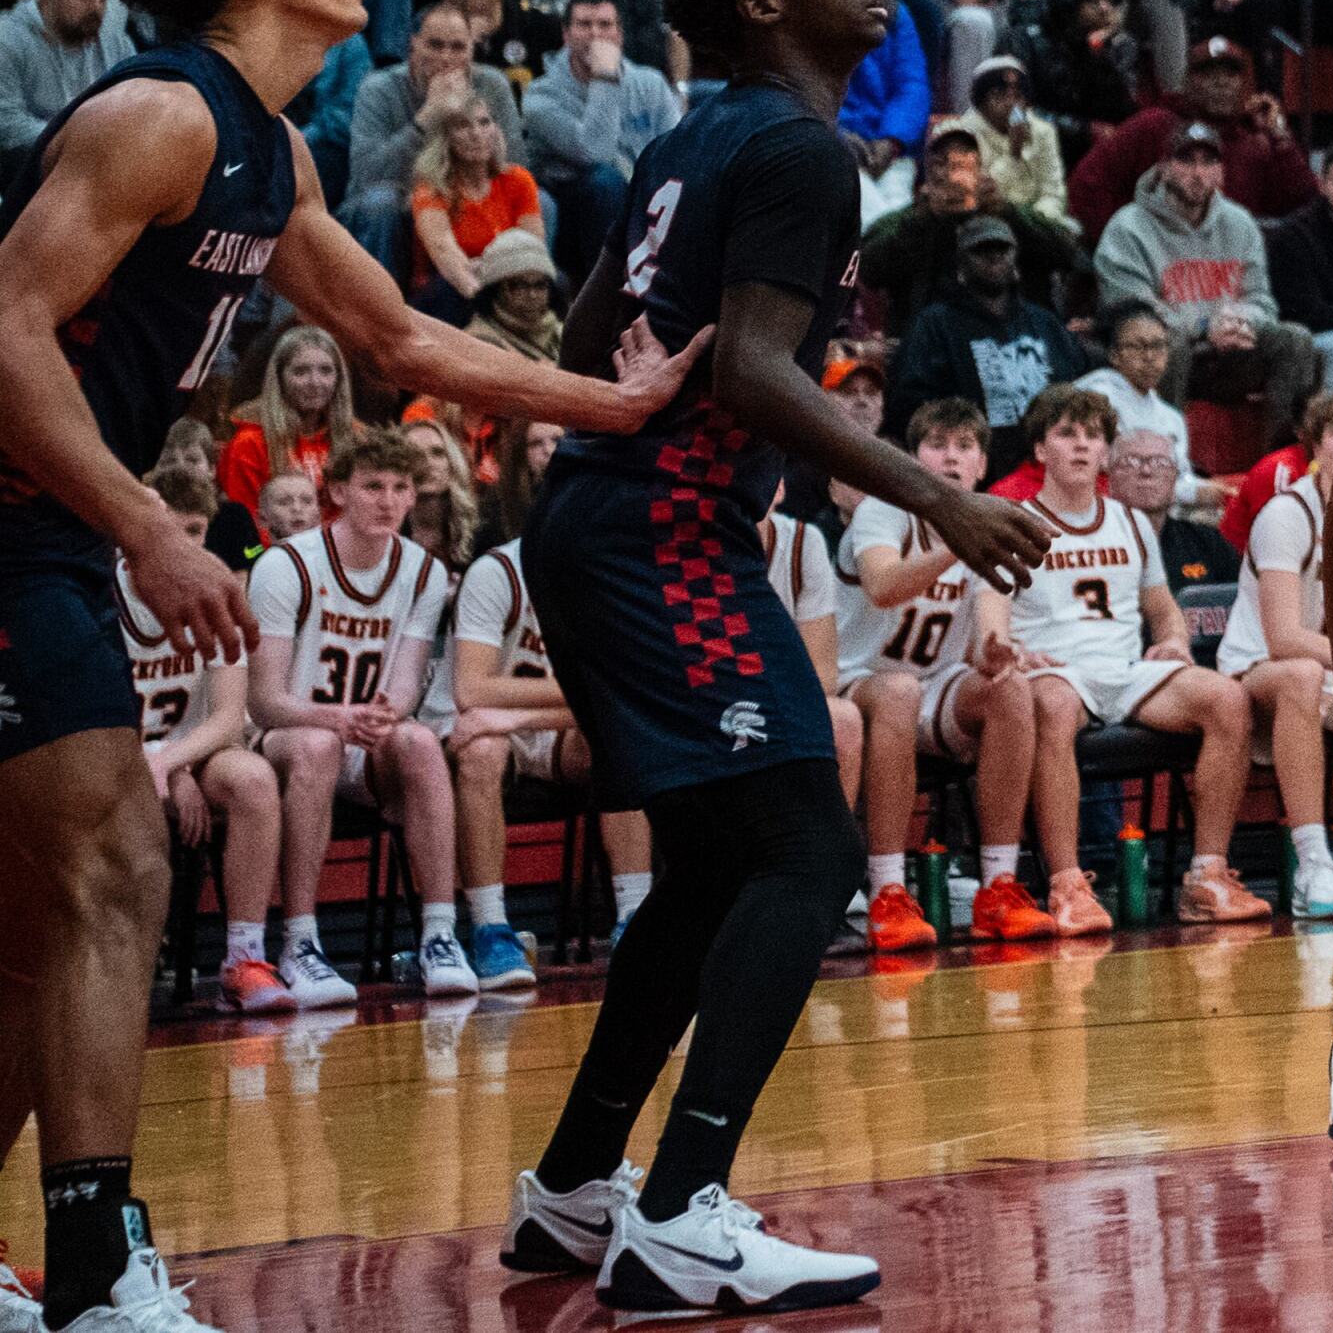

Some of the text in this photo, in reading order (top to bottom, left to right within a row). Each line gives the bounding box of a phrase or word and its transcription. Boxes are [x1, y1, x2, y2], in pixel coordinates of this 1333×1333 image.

[187, 228, 246, 274] EAST
[618, 177, 683, 299] 2
[175, 284, 246, 391] 11
[1045, 547, 1130, 571] ROCKFORD
[1072, 576, 1116, 621] 3
[882, 606, 952, 668] 10
[311, 645, 382, 705] 30
